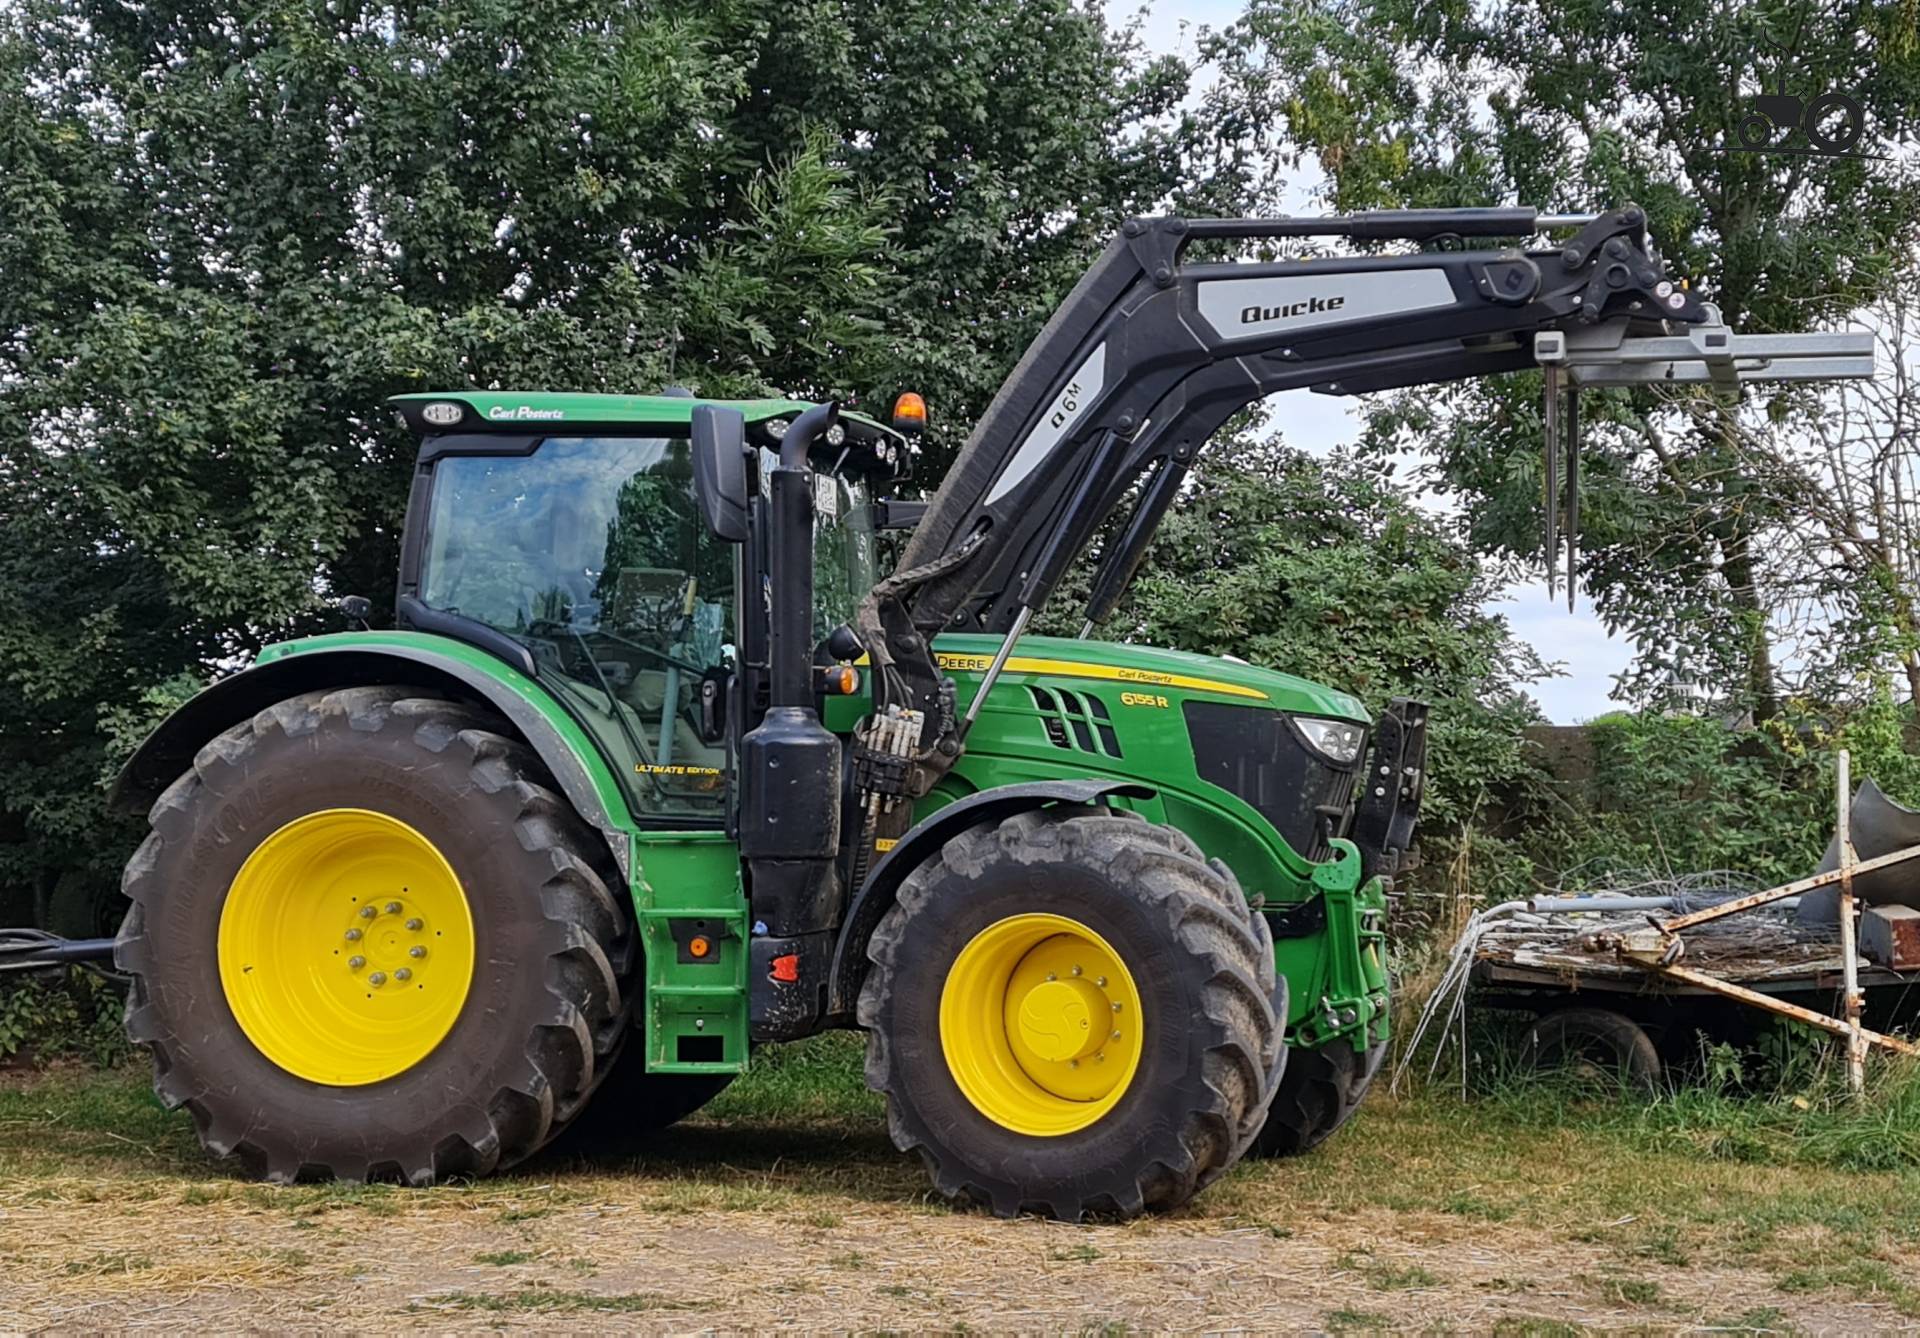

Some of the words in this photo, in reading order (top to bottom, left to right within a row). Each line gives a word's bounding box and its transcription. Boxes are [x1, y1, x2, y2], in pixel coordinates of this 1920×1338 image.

[1241, 296, 1345, 324] Quicke
[489, 406, 514, 418] Carl
[937, 655, 986, 669] DEERE
[1118, 669, 1136, 679] Carl
[634, 763, 685, 775] ULTIMATE
[687, 766, 720, 775] EDITION
